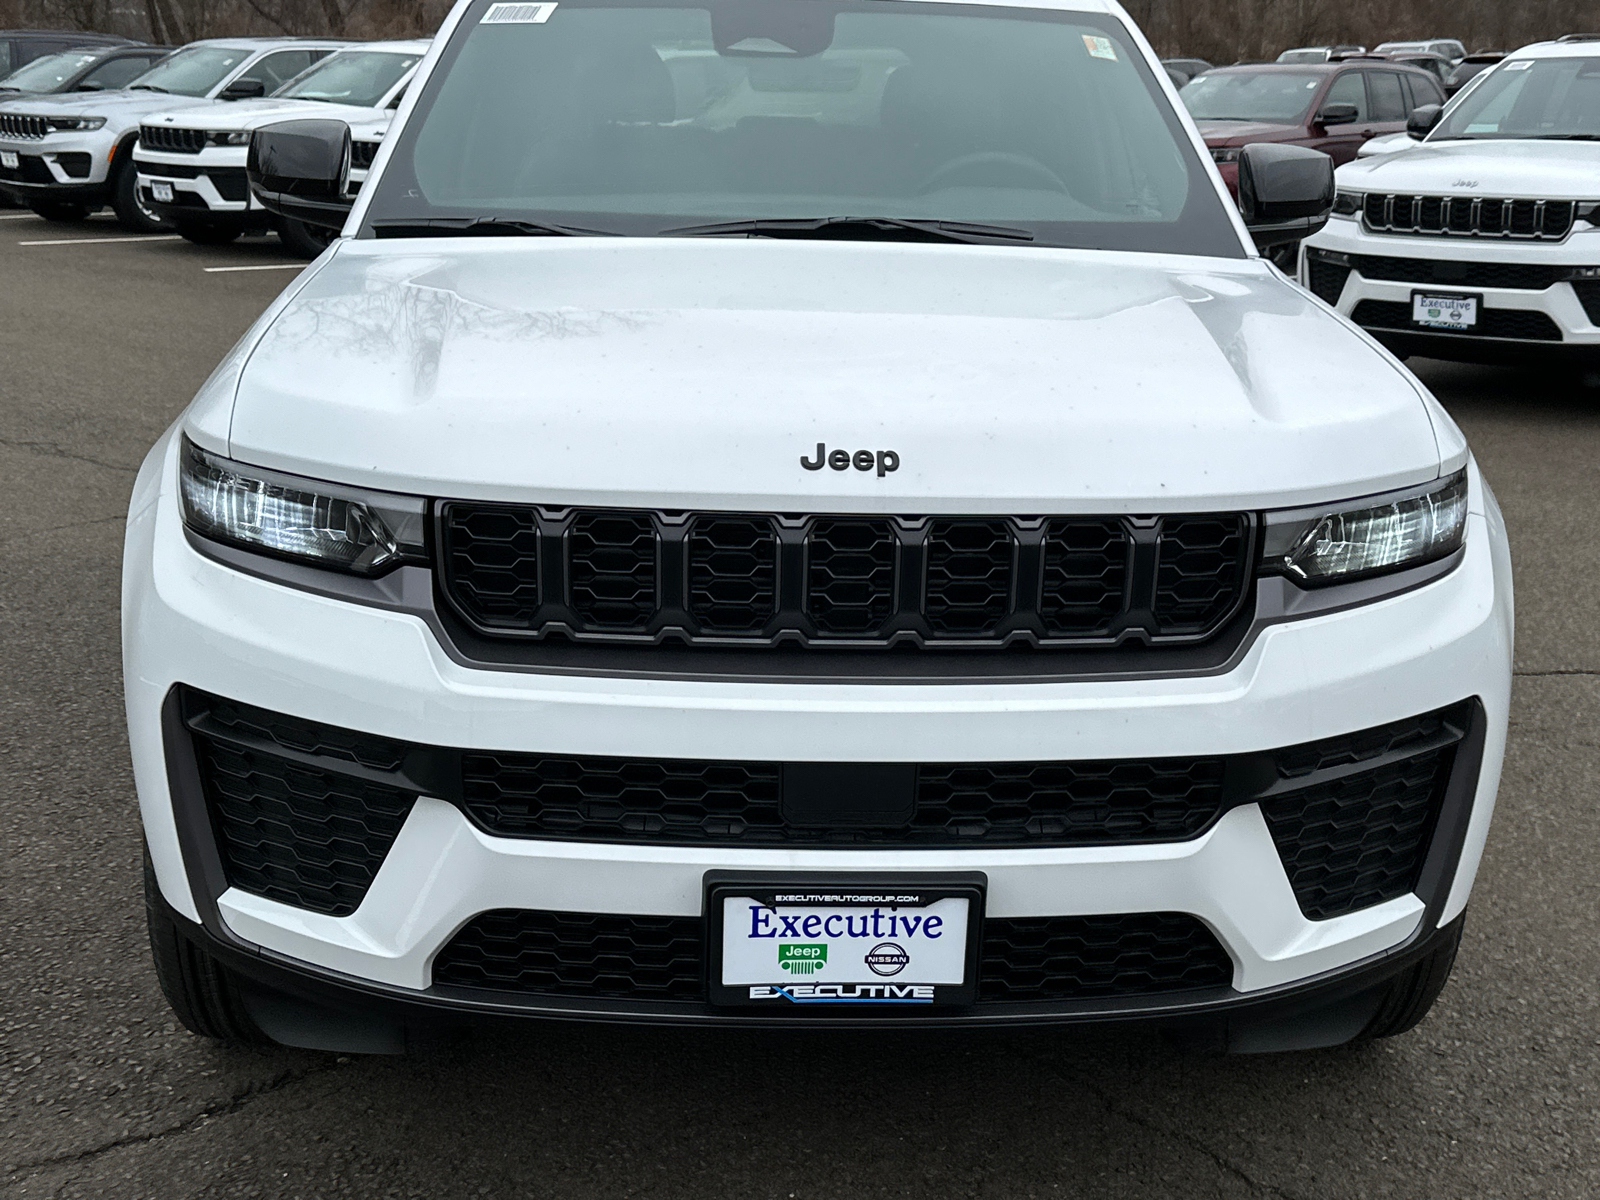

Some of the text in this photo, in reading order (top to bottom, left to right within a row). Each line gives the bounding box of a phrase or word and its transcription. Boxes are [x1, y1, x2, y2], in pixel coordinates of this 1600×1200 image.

[1452, 179, 1479, 188] Jeep
[1420, 297, 1471, 311] Executive
[800, 443, 900, 477] Jeep
[775, 895, 919, 903] EXECUTIVEAUTOGROUP.COM
[748, 905, 943, 939] Executive
[786, 946, 821, 959] Jeep
[749, 985, 935, 1000] EXECUTIVE
